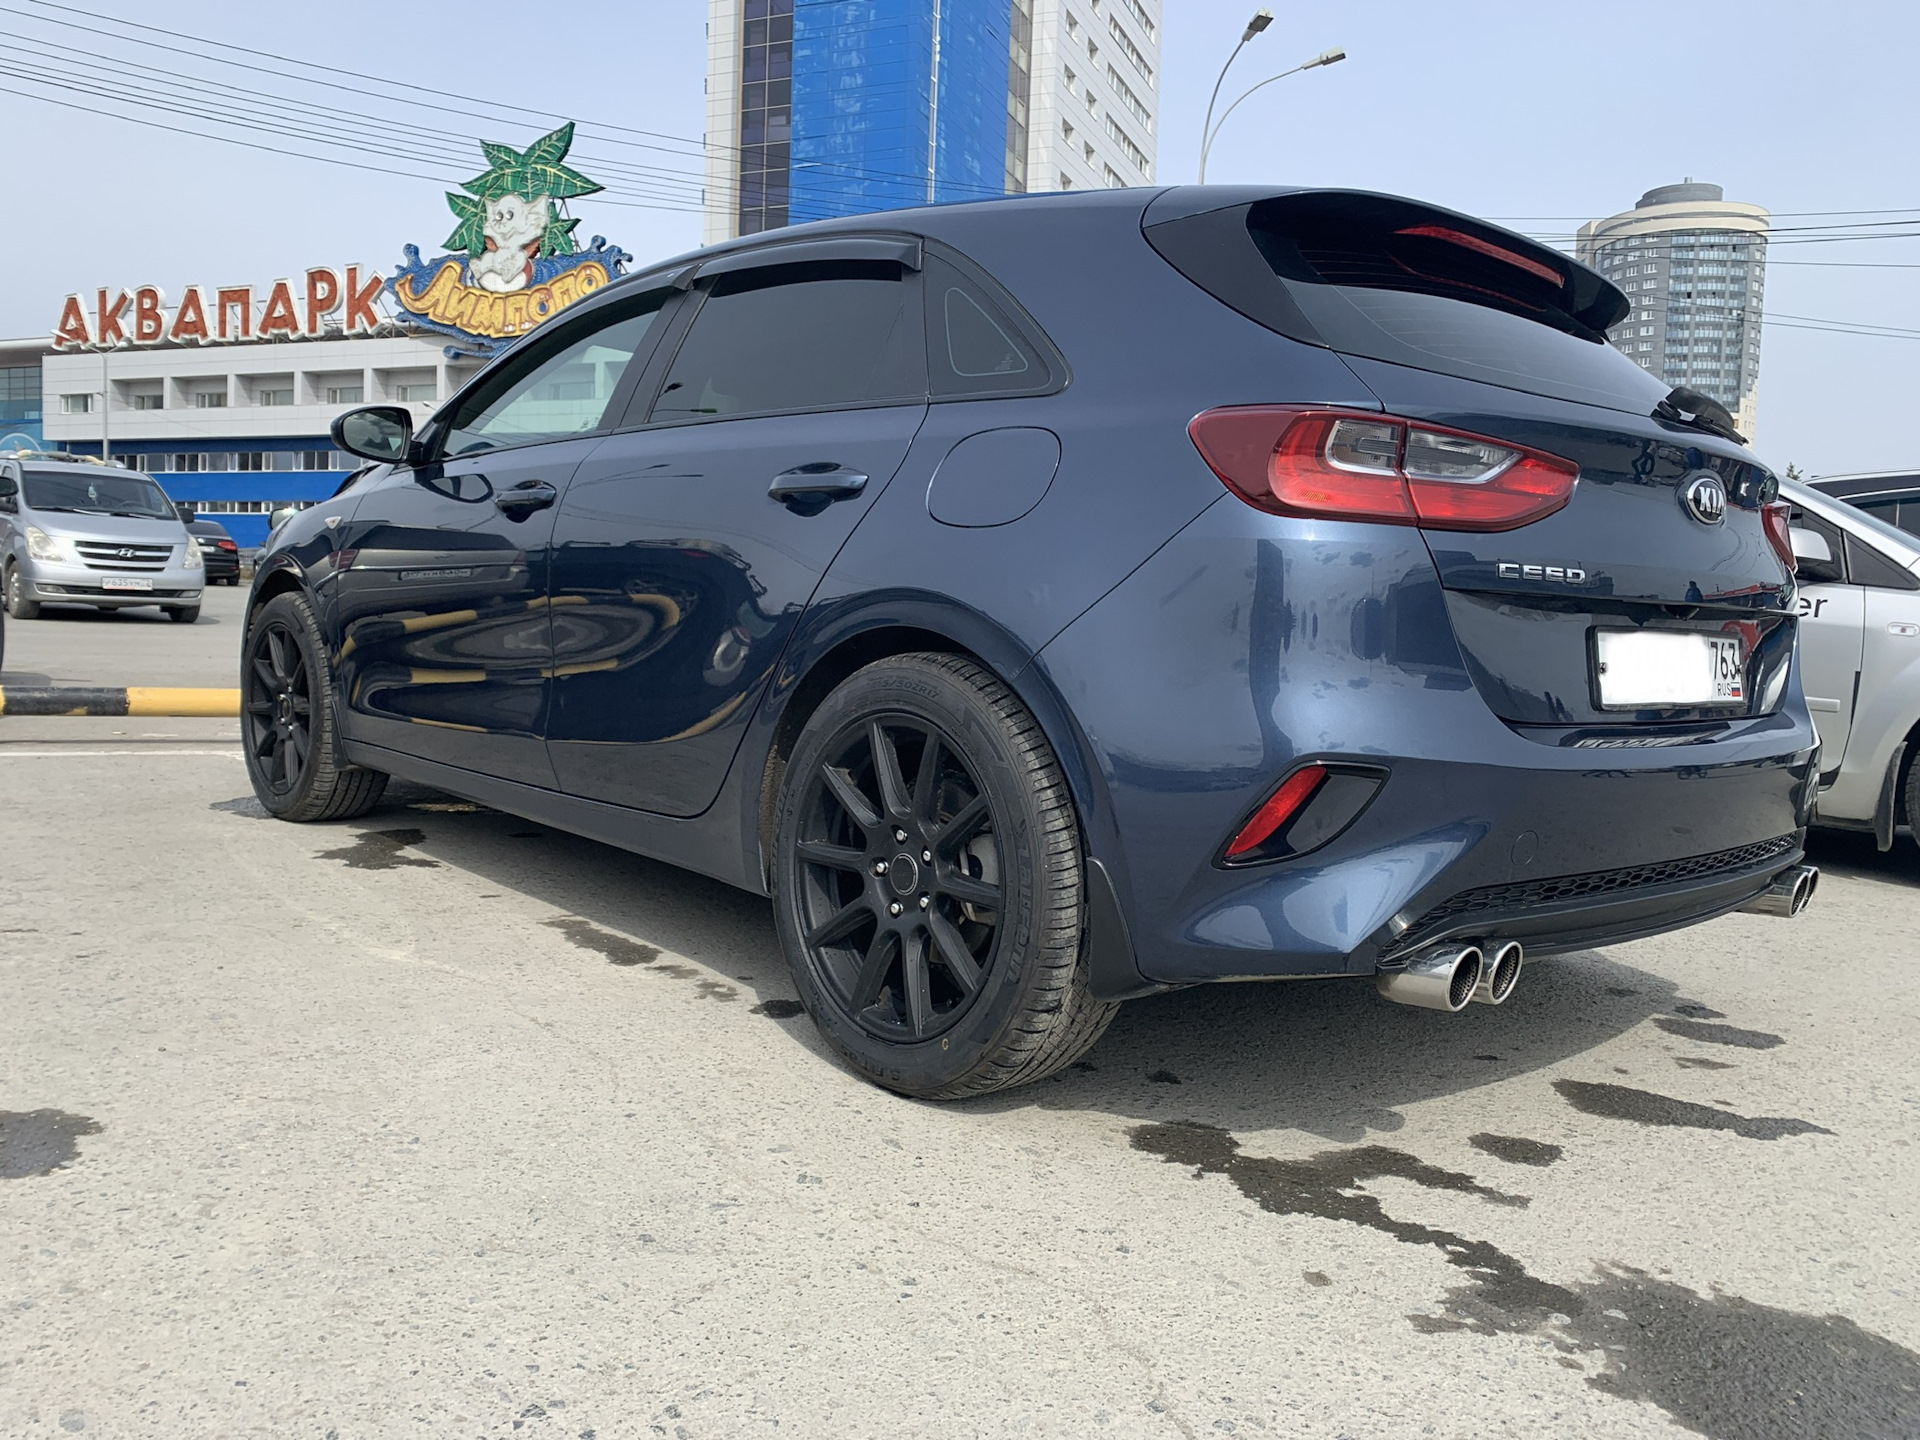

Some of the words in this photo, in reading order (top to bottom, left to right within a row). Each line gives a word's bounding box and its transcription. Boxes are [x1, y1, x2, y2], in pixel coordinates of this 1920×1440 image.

[51, 262, 388, 352] АКВАПАРК
[1497, 562, 1586, 584] CEED
[1710, 641, 1737, 681] 763
[1717, 682, 1732, 697] RUS
